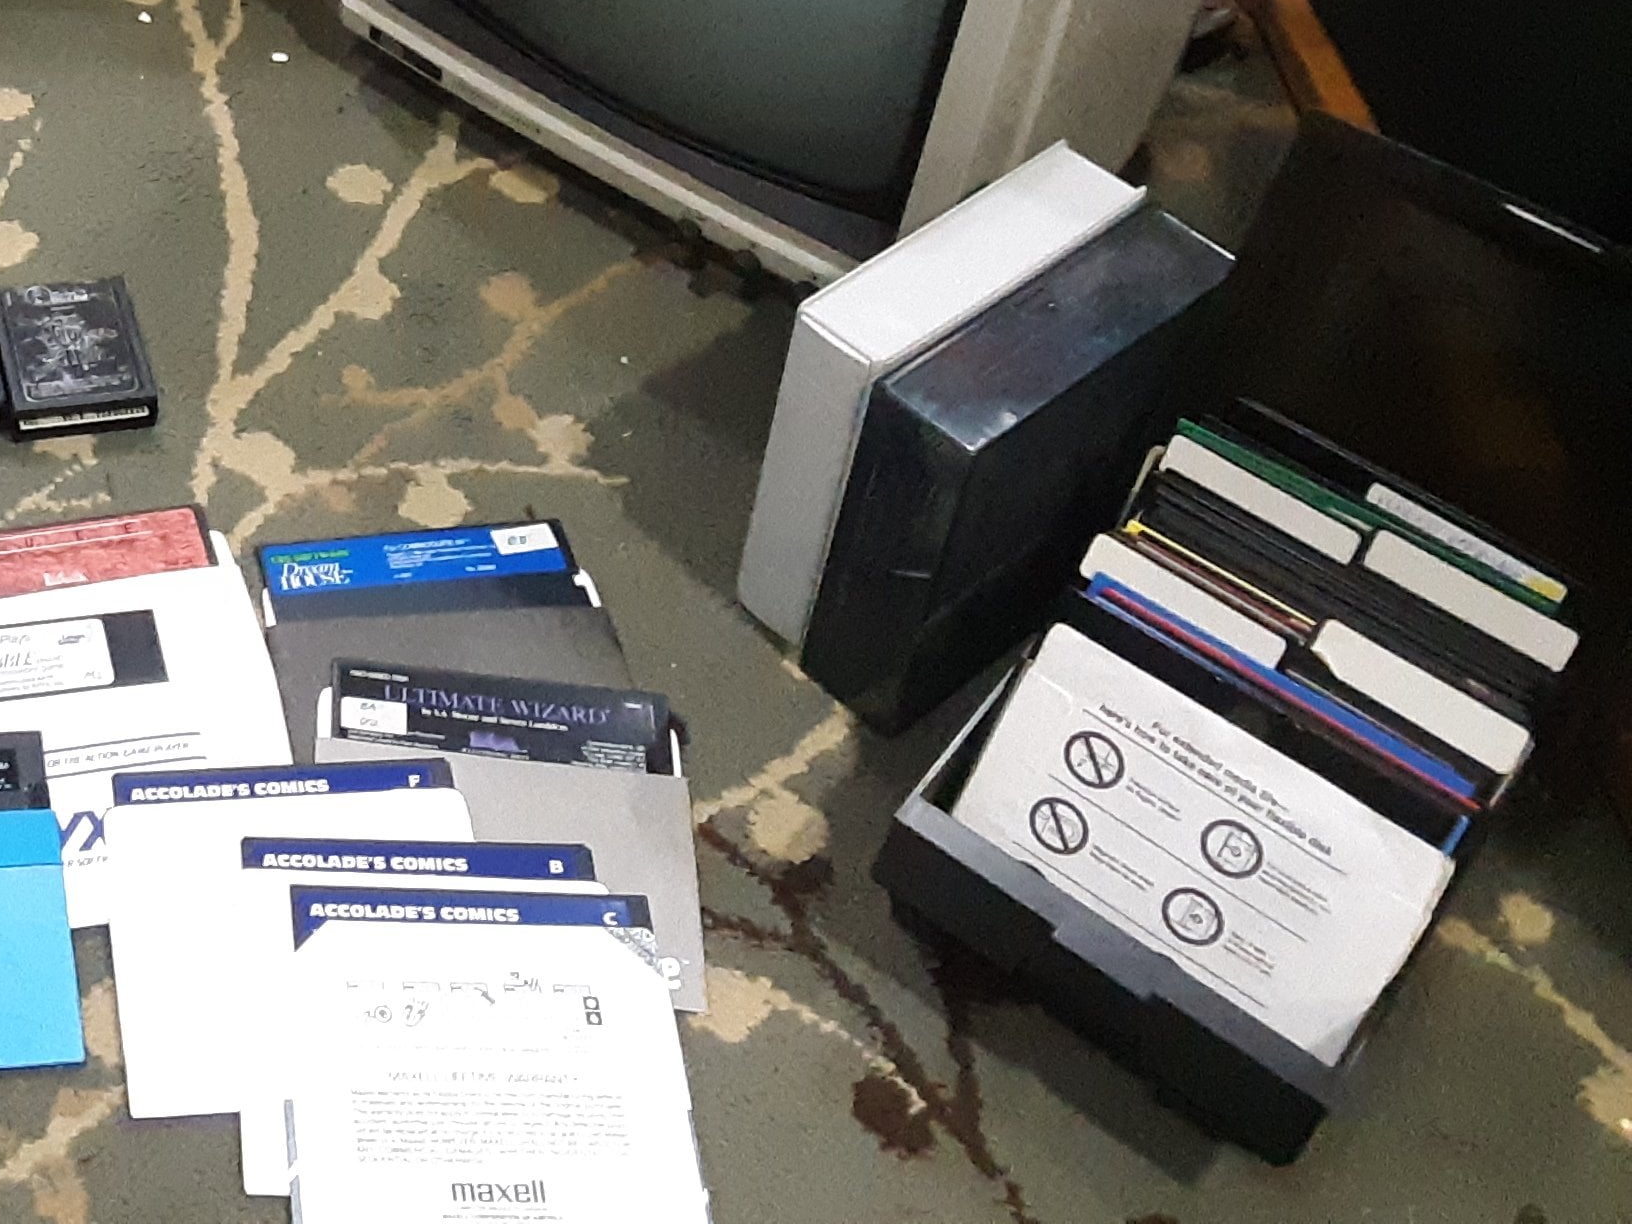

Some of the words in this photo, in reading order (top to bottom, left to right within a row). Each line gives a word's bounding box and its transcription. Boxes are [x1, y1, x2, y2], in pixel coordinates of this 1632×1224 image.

[384, 683, 504, 715] ULTIMATE
[510, 698, 606, 725] WIZARD
[129, 782, 251, 802] ACCOLADE'S
[253, 777, 331, 796] COMICS
[261, 852, 388, 871] ACCOLADE'S
[389, 855, 469, 873] COMICS
[548, 858, 565, 875] B
[309, 902, 438, 922] ACCOLADE'S
[439, 904, 520, 923] COMICS
[602, 910, 619, 927] C
[451, 1179, 547, 1204] maxell
